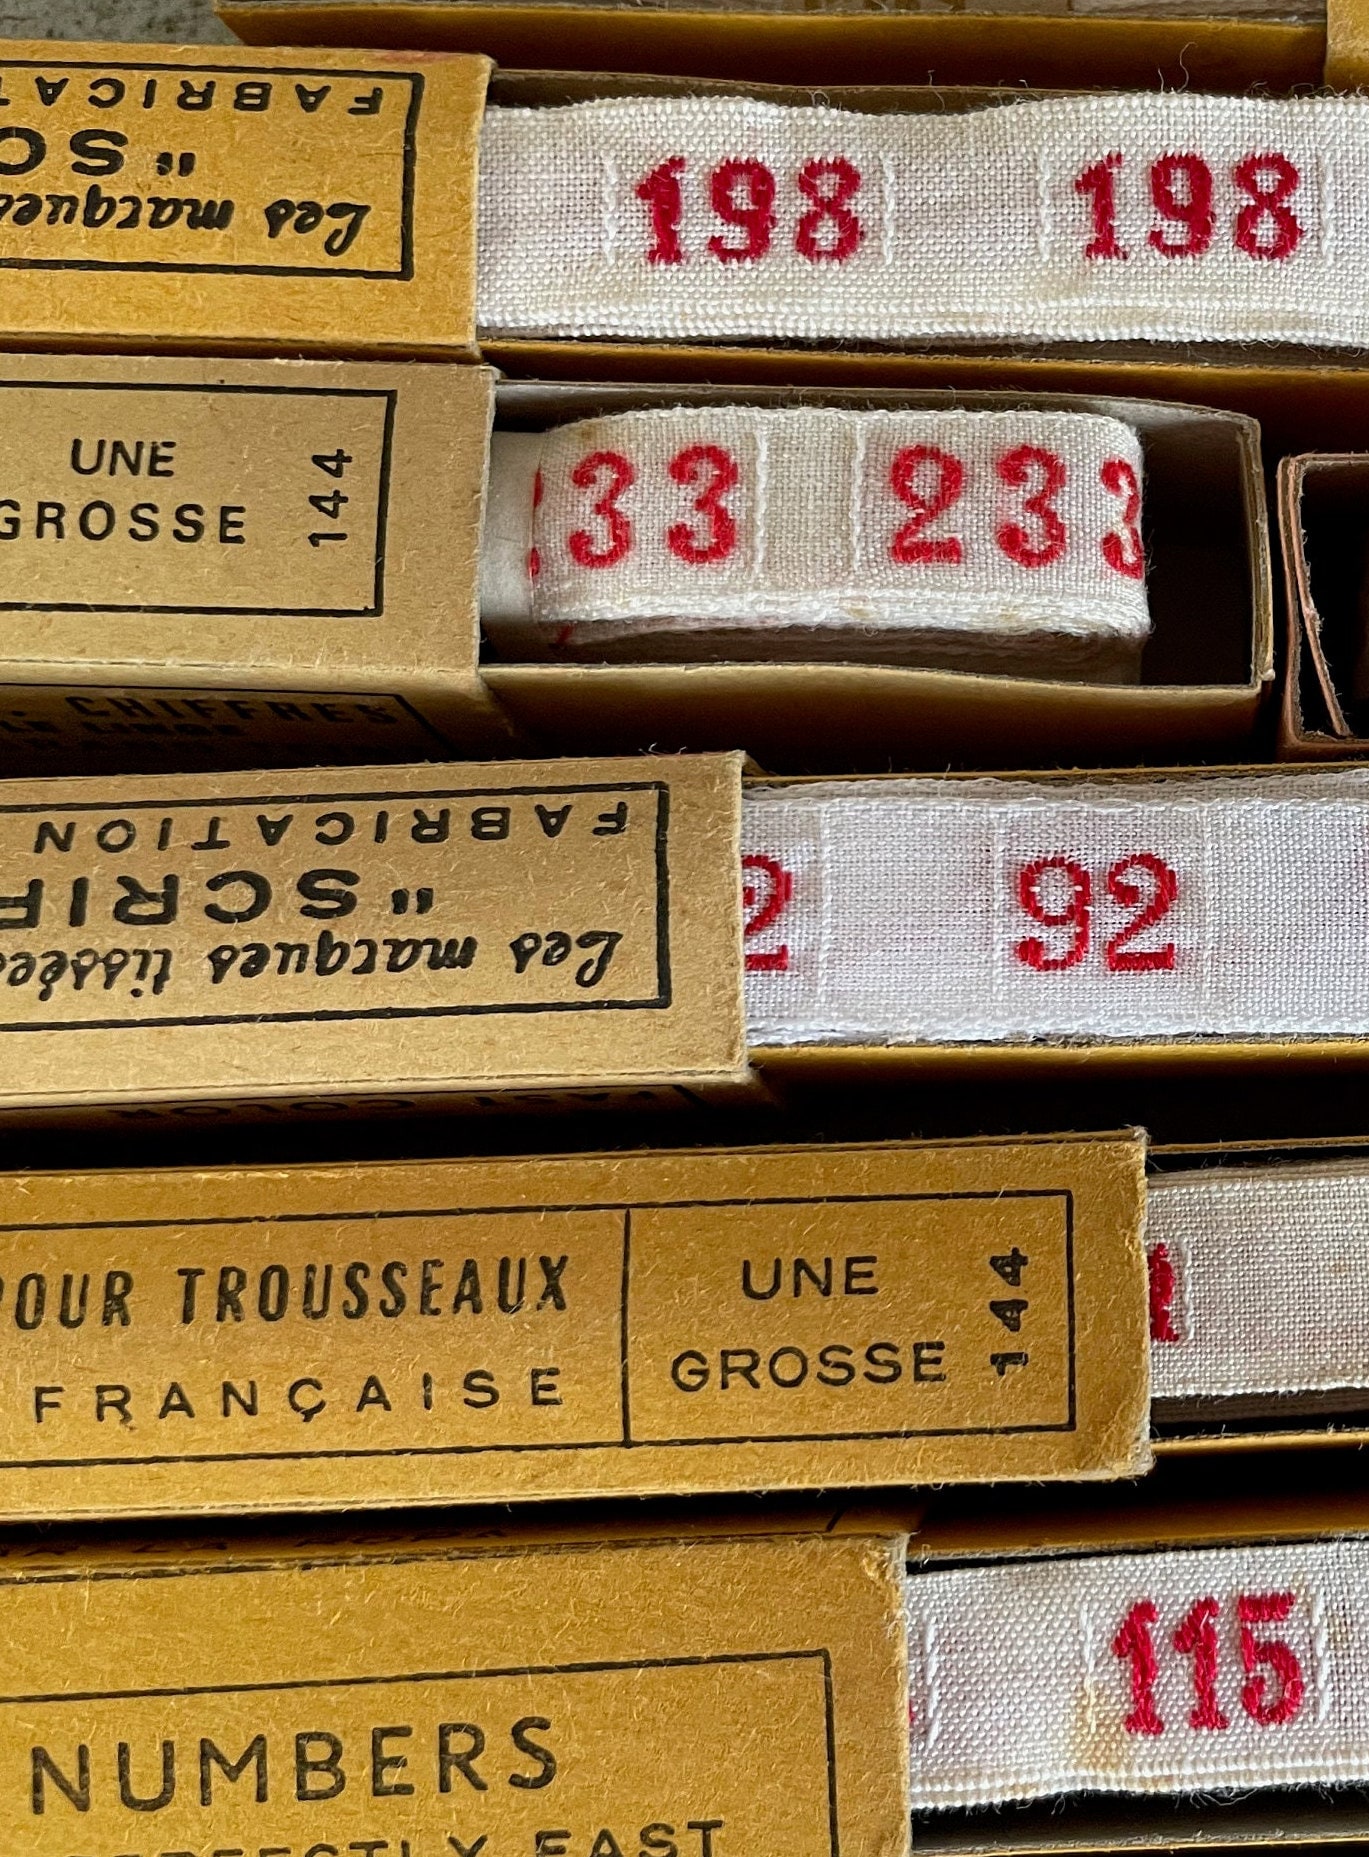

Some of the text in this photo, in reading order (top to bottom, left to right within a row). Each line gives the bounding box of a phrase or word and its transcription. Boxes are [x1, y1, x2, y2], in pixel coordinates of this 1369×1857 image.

[264, 199, 372, 257] Les
[636, 151, 1303, 265] 198 198
[71, 438, 177, 478] UNE
[0, 498, 247, 545] GROSSE
[308, 448, 353, 548] 144
[528, 444, 739, 577] 33
[64, 695, 400, 724] CHIFFRES
[33, 800, 629, 853] FABRICATION
[1014, 852, 1178, 973] 92
[0, 929, 624, 1001] Les marques tissée
[0, 1254, 569, 1331] OUR TROUSSEAUX
[742, 1255, 879, 1300] UNE
[988, 1246, 1029, 1378] 144
[34, 1366, 563, 1425] FRANÇAISE
[671, 1340, 947, 1393] GROSSE
[1112, 1593, 1305, 1736] 115
[31, 1716, 558, 1816] NUMBERS
